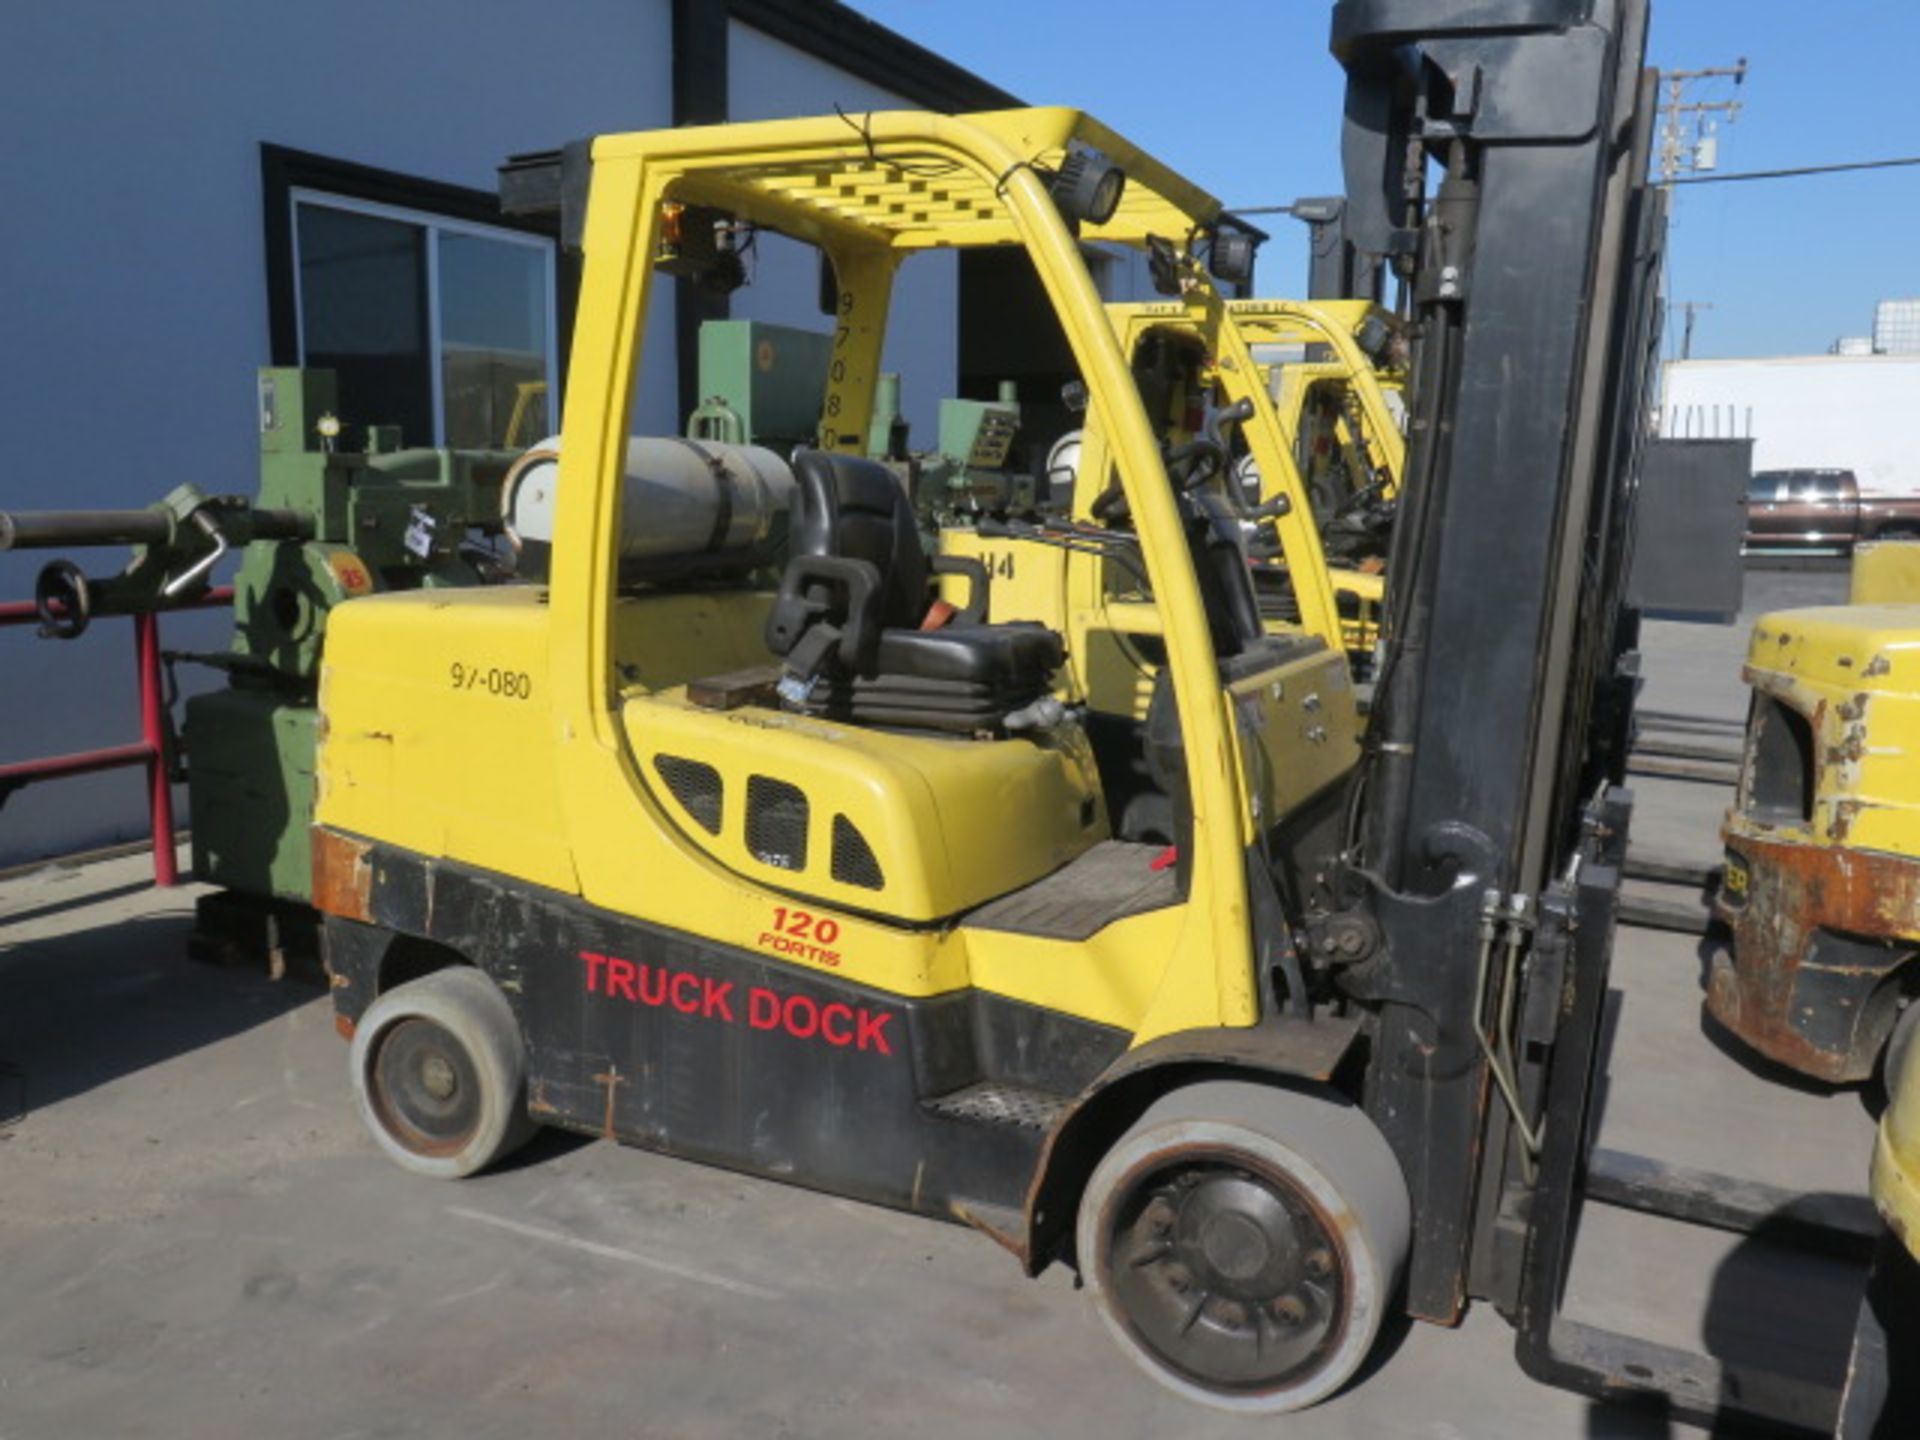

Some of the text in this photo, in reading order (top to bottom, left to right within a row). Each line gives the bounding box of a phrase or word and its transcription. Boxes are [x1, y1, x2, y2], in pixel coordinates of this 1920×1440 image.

[773, 906, 840, 945] 120
[758, 932, 842, 968] FORTIS
[578, 950, 893, 1056] TRUCK DOCK
